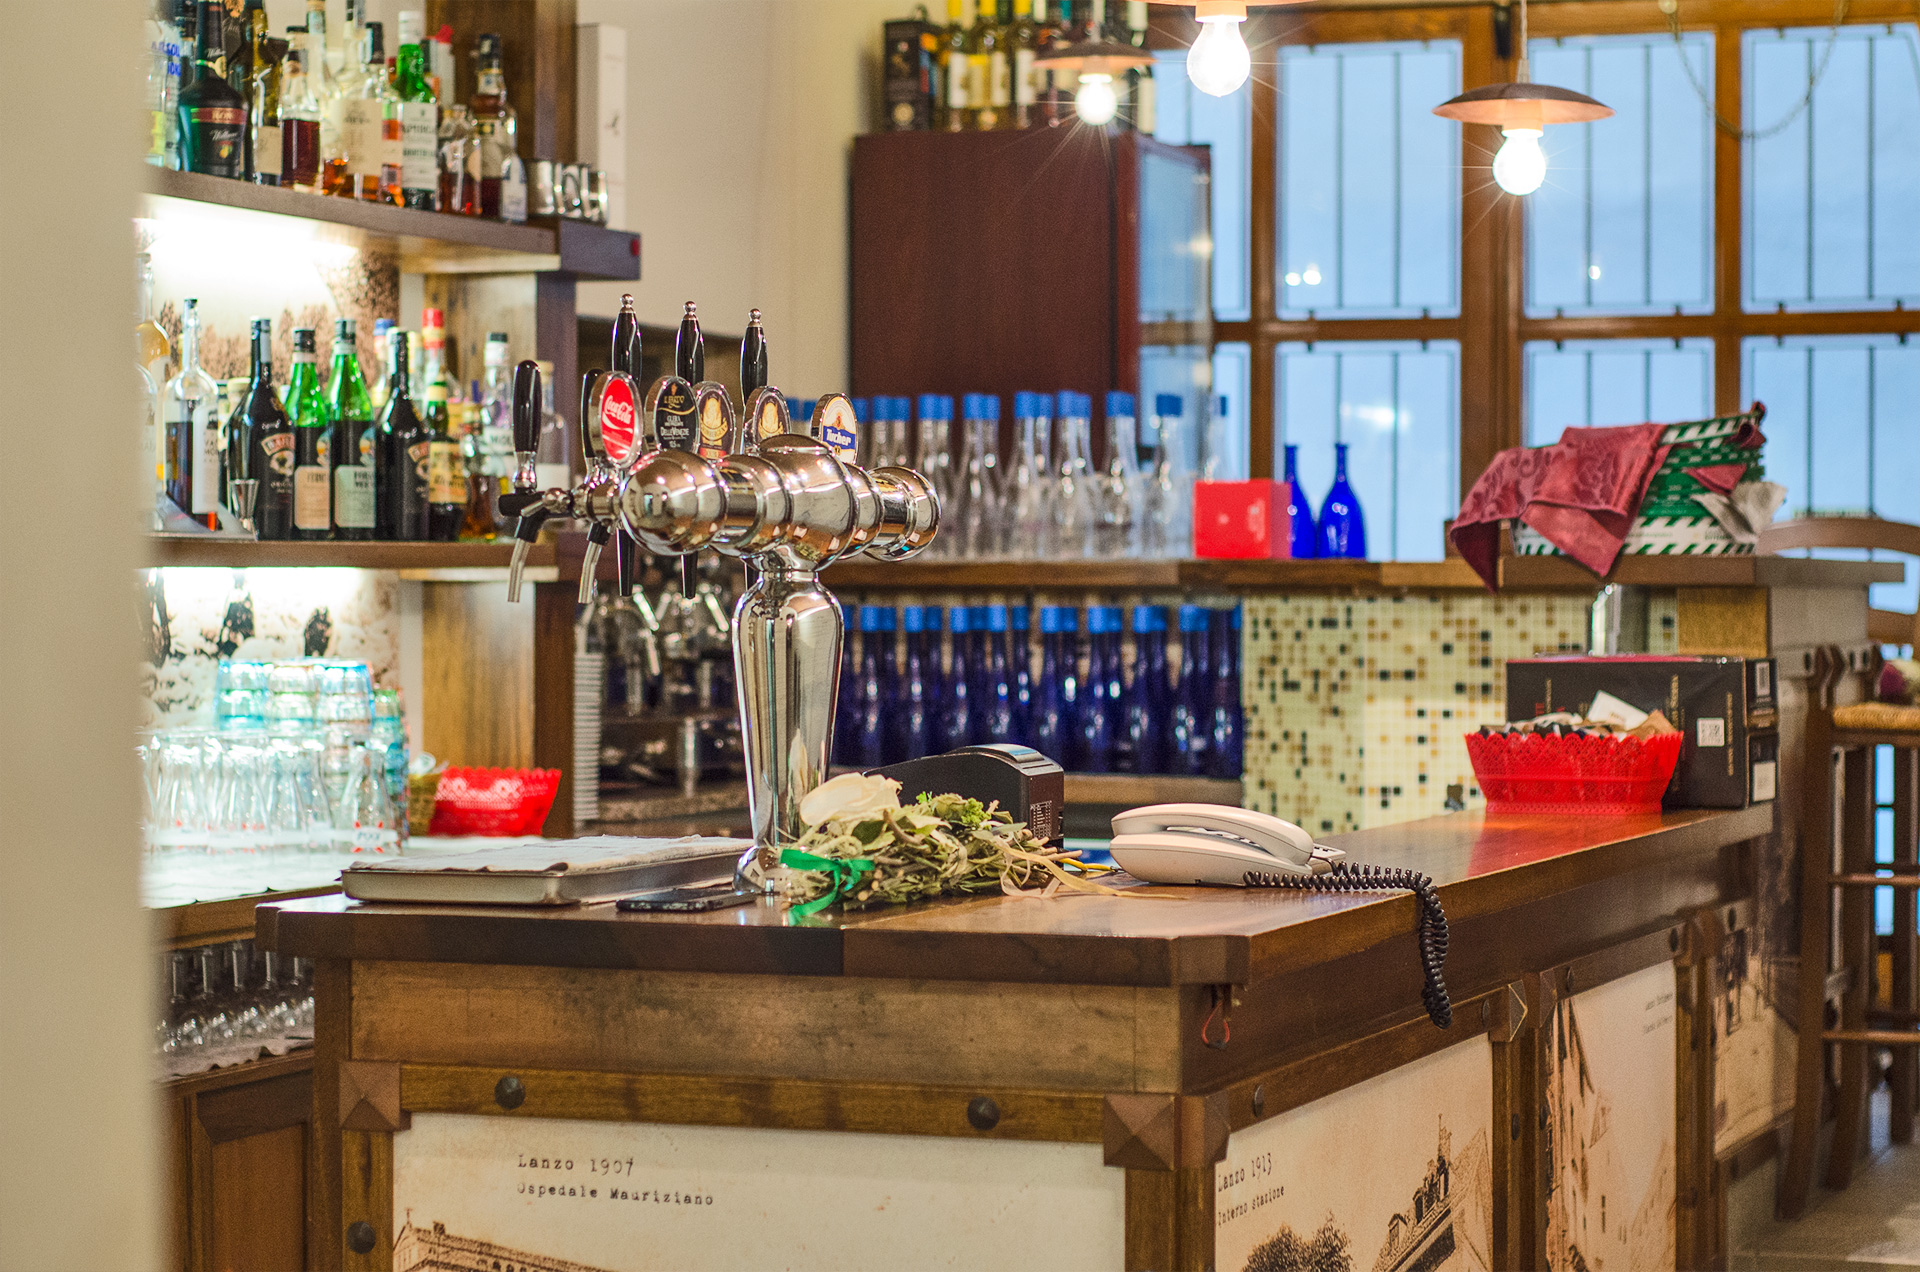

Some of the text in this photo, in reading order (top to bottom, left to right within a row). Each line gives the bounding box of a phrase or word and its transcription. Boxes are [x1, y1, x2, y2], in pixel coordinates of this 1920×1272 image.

[826, 428, 852, 446] Tucher
[517, 1154, 634, 1176] Lanzo 1907
[1218, 1152, 1272, 1192] Lanzo 1913
[517, 1182, 714, 1206] Ospedale Mauriziano
[1218, 1186, 1285, 1226] Interno stazione
